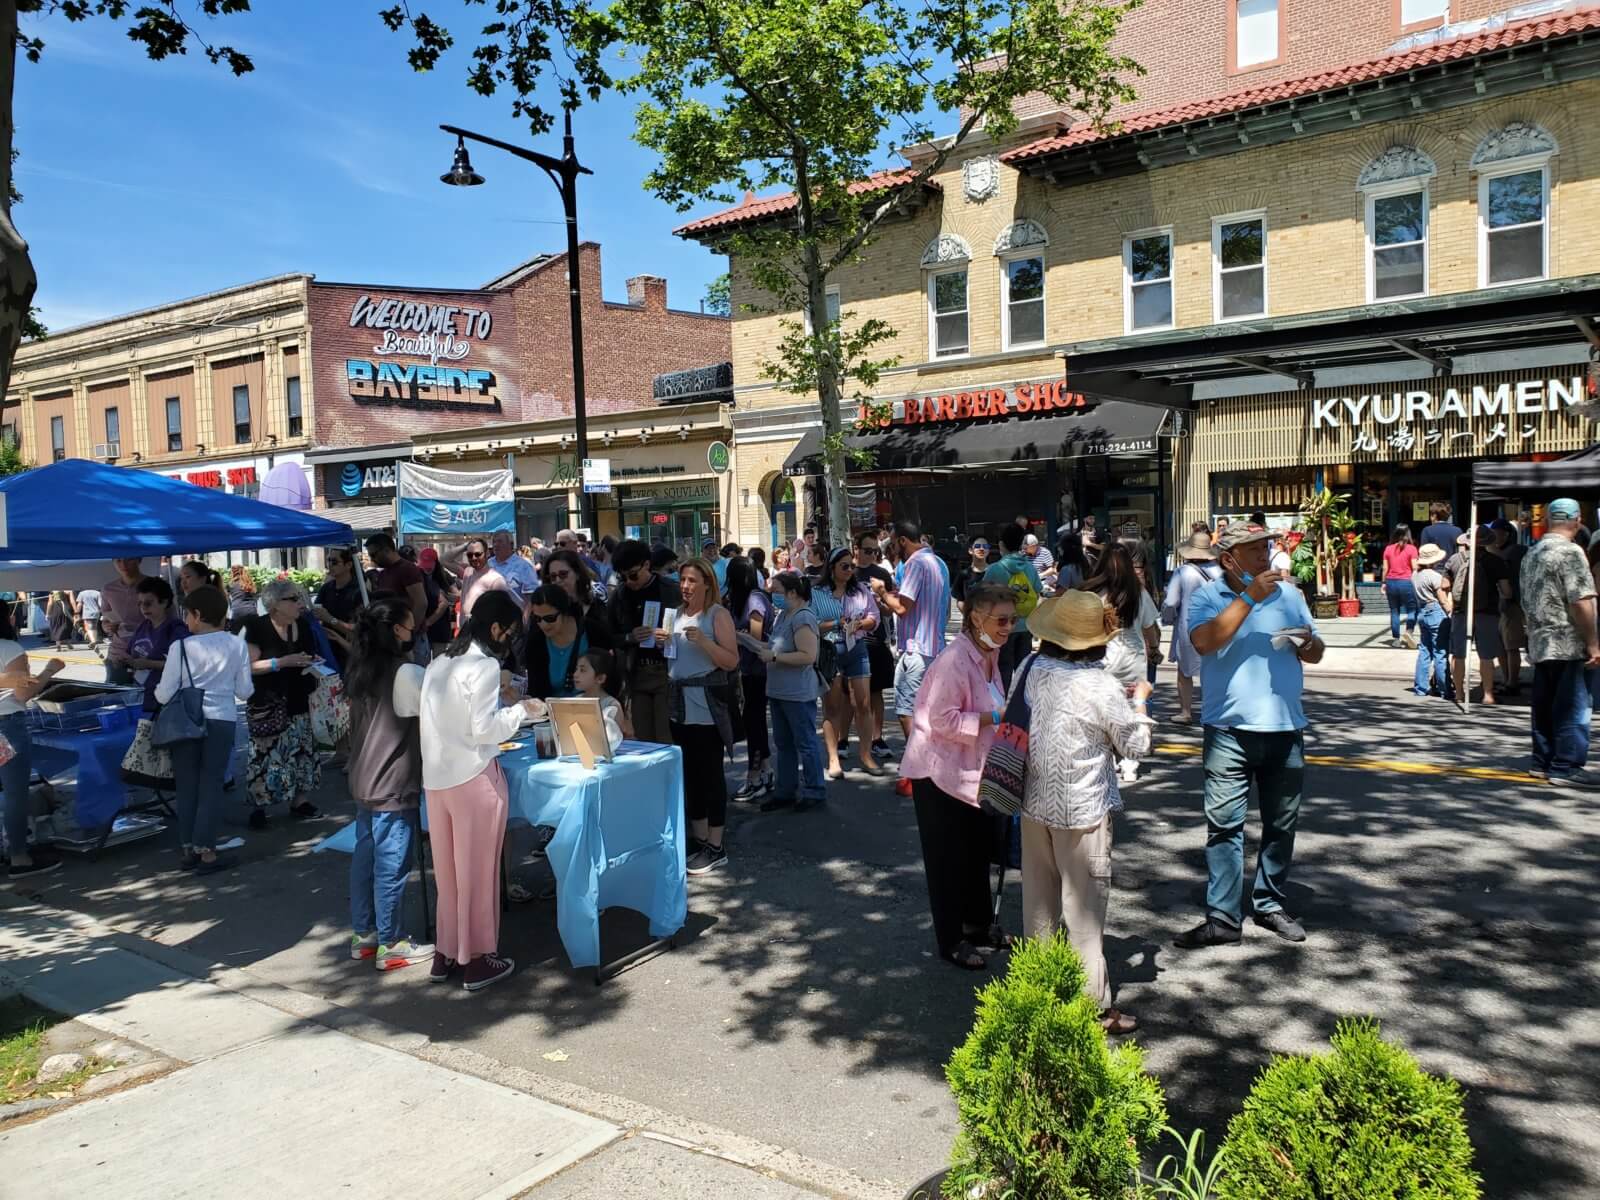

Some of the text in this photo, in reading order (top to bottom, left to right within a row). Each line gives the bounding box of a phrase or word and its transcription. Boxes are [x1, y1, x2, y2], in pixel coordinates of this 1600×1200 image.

[350, 295, 493, 340] WELCOME TO
[373, 329, 470, 365] Beautiful
[346, 359, 498, 408] BAYSIDE
[1313, 376, 1582, 428] KYURAMEN
[902, 387, 1009, 425] BARBER
[1088, 440, 1152, 454] 718-224-4114
[663, 485, 711, 498] SOUVLAKI
[455, 509, 489, 525] AT&T
